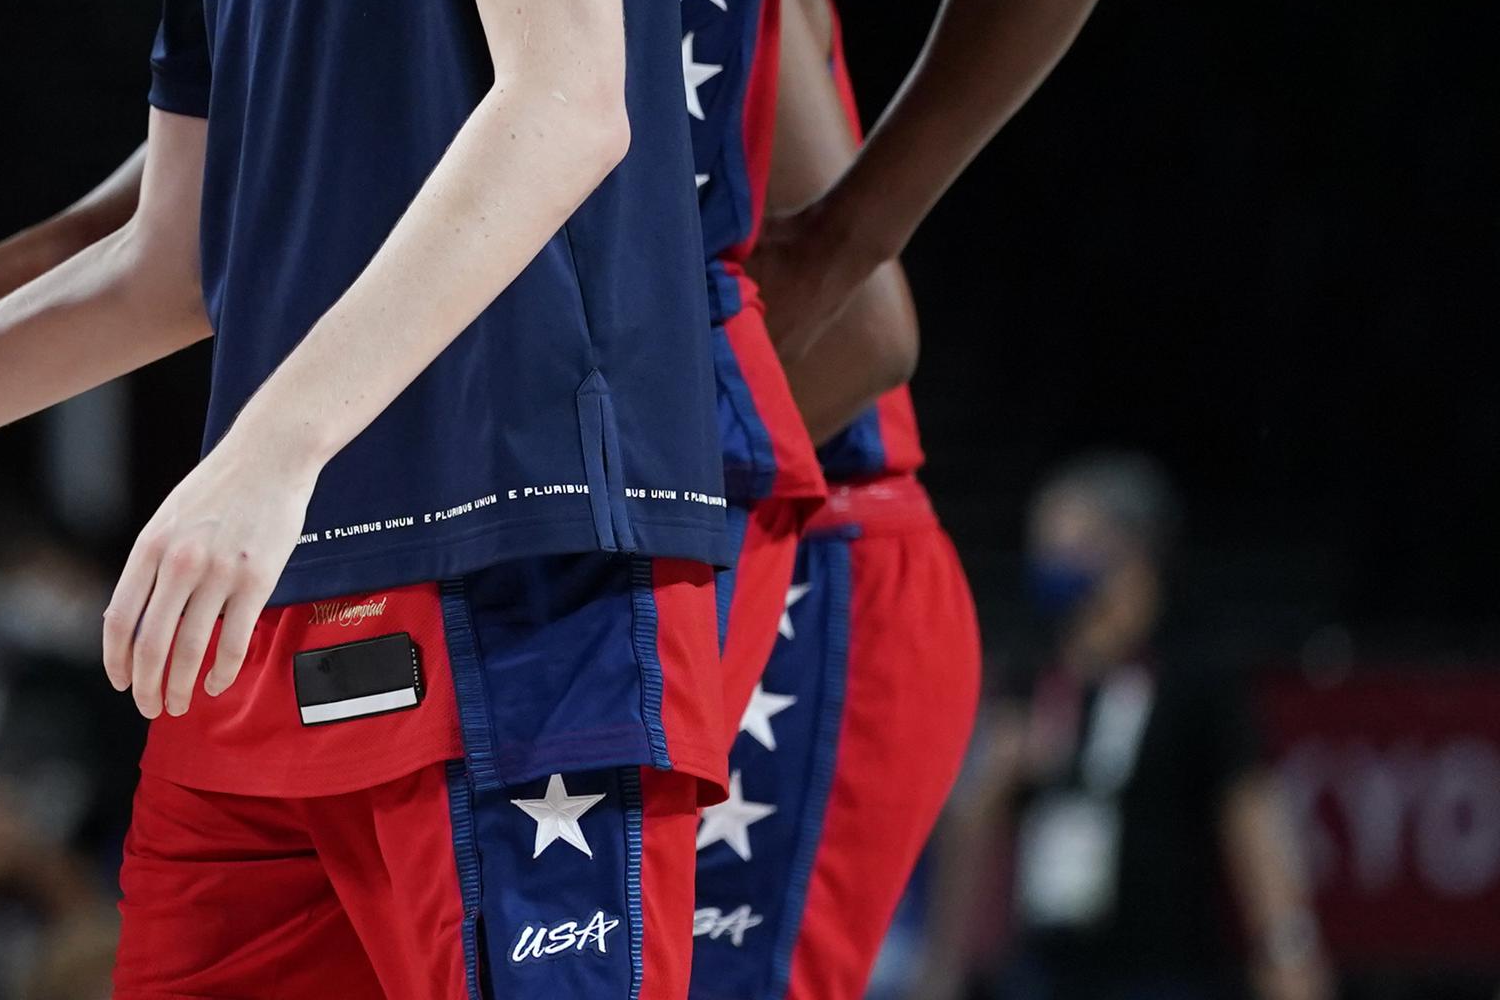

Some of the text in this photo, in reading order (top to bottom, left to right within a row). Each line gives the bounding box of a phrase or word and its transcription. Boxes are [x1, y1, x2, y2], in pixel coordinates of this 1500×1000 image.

[325, 530, 333, 540] E
[335, 521, 382, 538] PLURIBUS
[385, 516, 414, 529] UNUM
[424, 513, 432, 523] E
[435, 502, 472, 521] PLURIBUS
[474, 494, 498, 509] UNUM
[508, 489, 518, 500] E
[651, 489, 676, 500] UNUM
[512, 911, 619, 962] USA
[693, 904, 764, 947] SA
